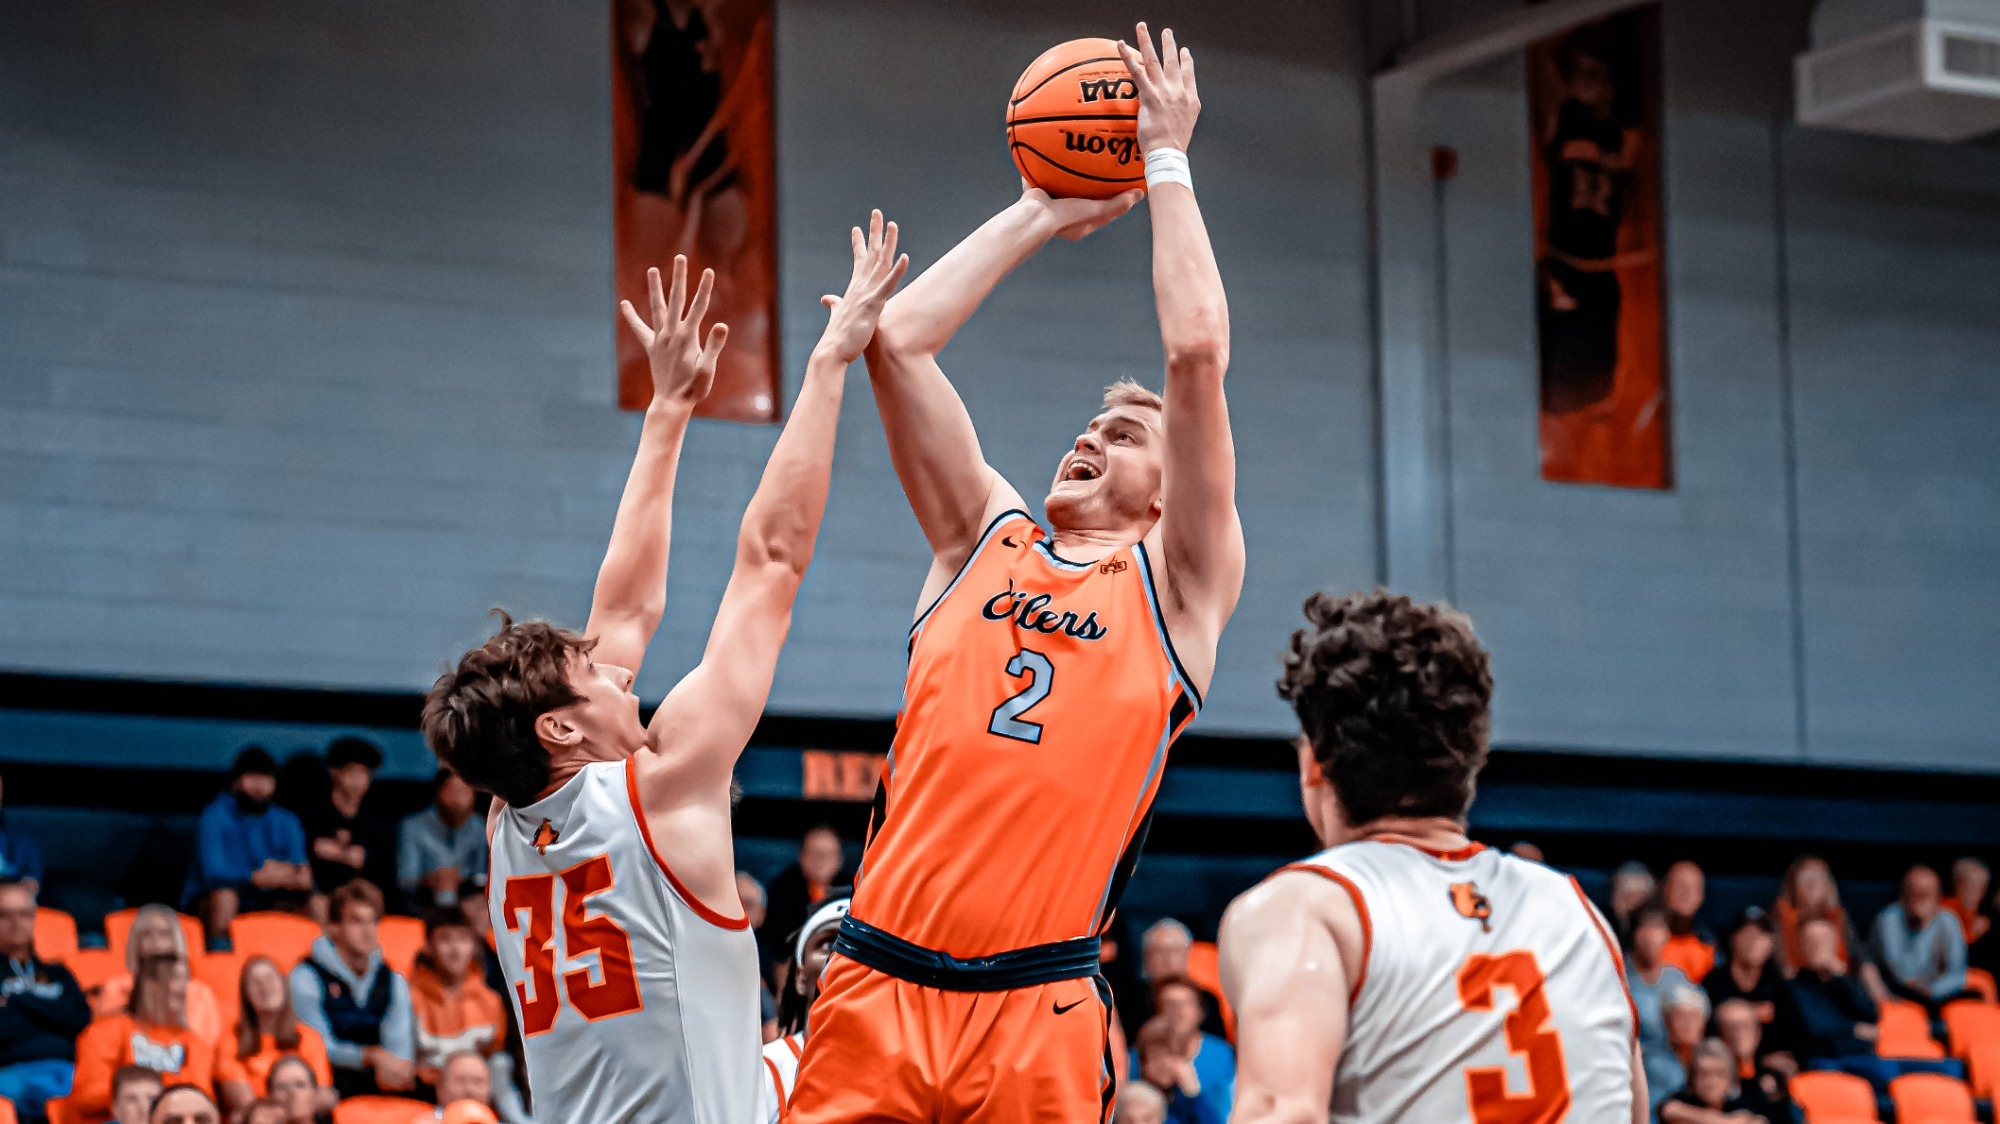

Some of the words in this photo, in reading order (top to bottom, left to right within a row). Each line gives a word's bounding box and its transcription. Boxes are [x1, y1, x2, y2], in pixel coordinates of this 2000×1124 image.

[1080, 78, 1139, 104] CAA
[1065, 131, 1143, 165] ilson
[987, 647, 1055, 745] 2
[503, 852, 644, 1038] 35
[1456, 948, 1571, 1124] 3
